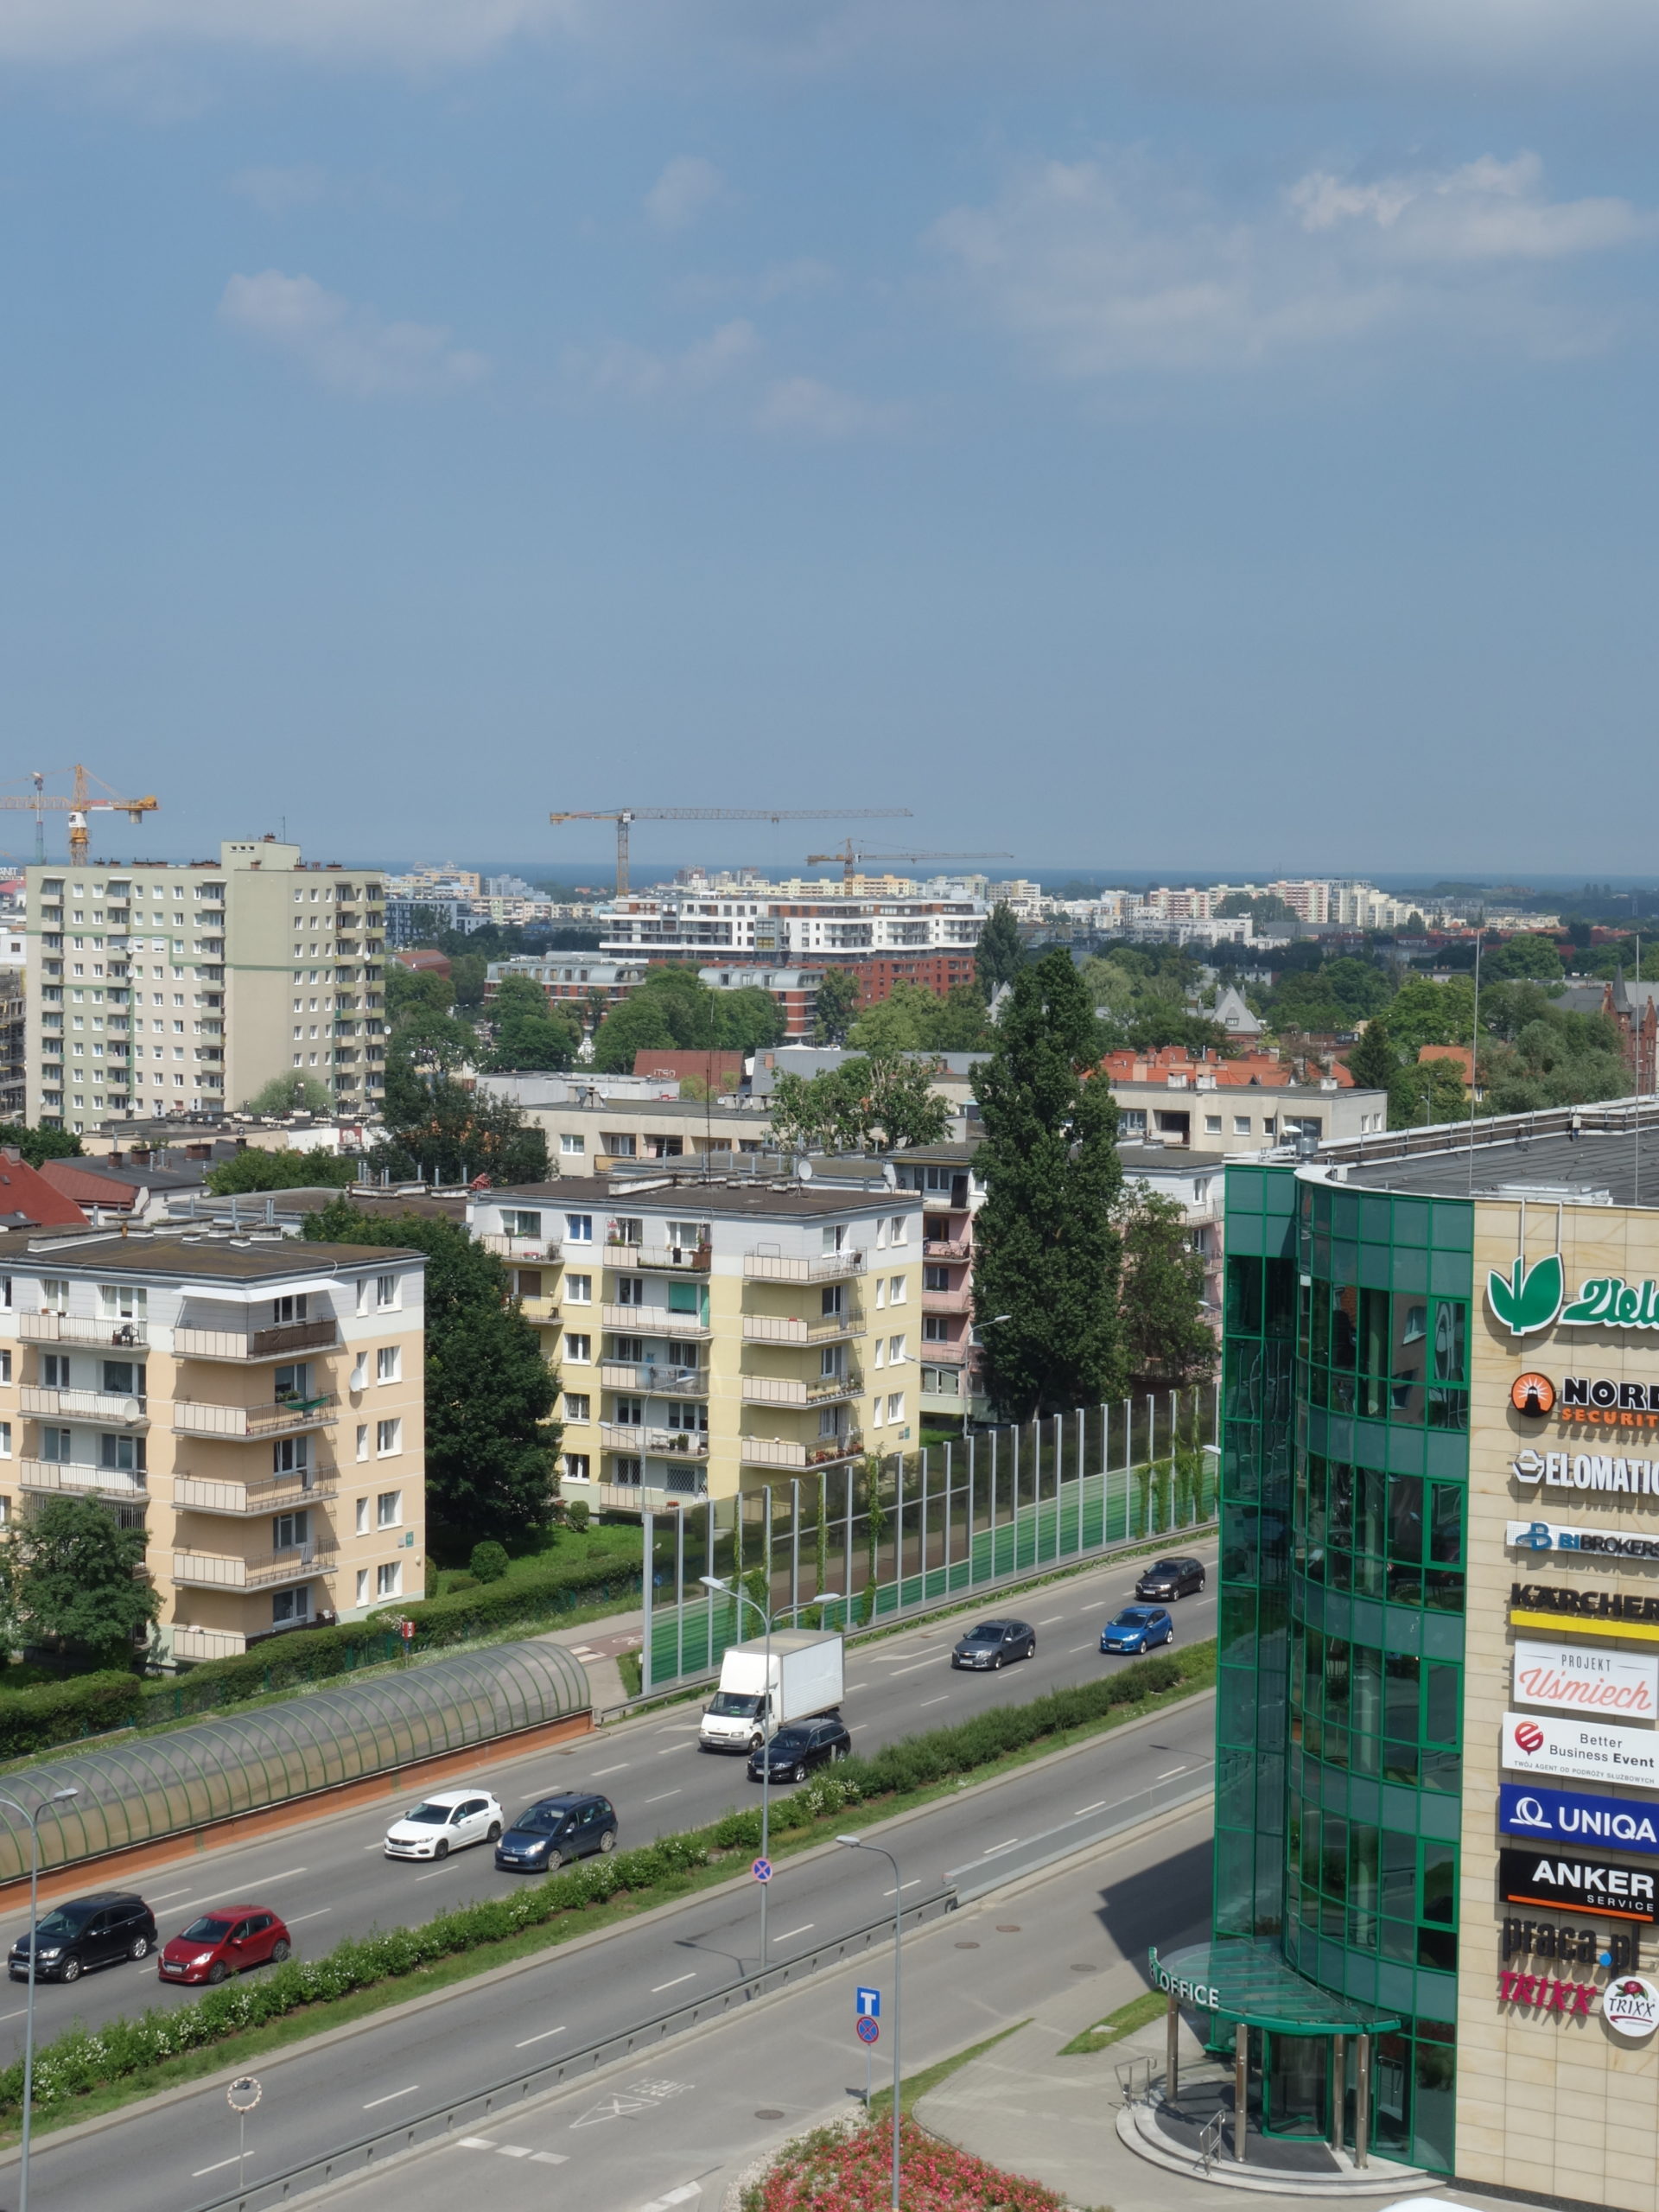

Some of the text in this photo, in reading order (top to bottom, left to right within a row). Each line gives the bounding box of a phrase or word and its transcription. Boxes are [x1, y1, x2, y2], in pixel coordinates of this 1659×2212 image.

[1561, 1654, 1611, 1672] PROJEKT
[1519, 1667, 1652, 1711] Uśmiech
[1580, 1733, 1623, 1749] Better
[1535, 1763, 1557, 1771] AGENT
[1550, 1745, 1655, 1768] Business Event
[1559, 1807, 1657, 1843] UNIQA
[1532, 1859, 1655, 1899] ANKER
[1586, 1895, 1655, 1912] SERVICE
[1503, 1916, 1640, 1980] praca.pl
[1160, 1970, 1220, 2009] OFFICE
[1500, 1970, 1598, 2016] TRIXX
[1609, 1997, 1656, 2018] TRIXX
